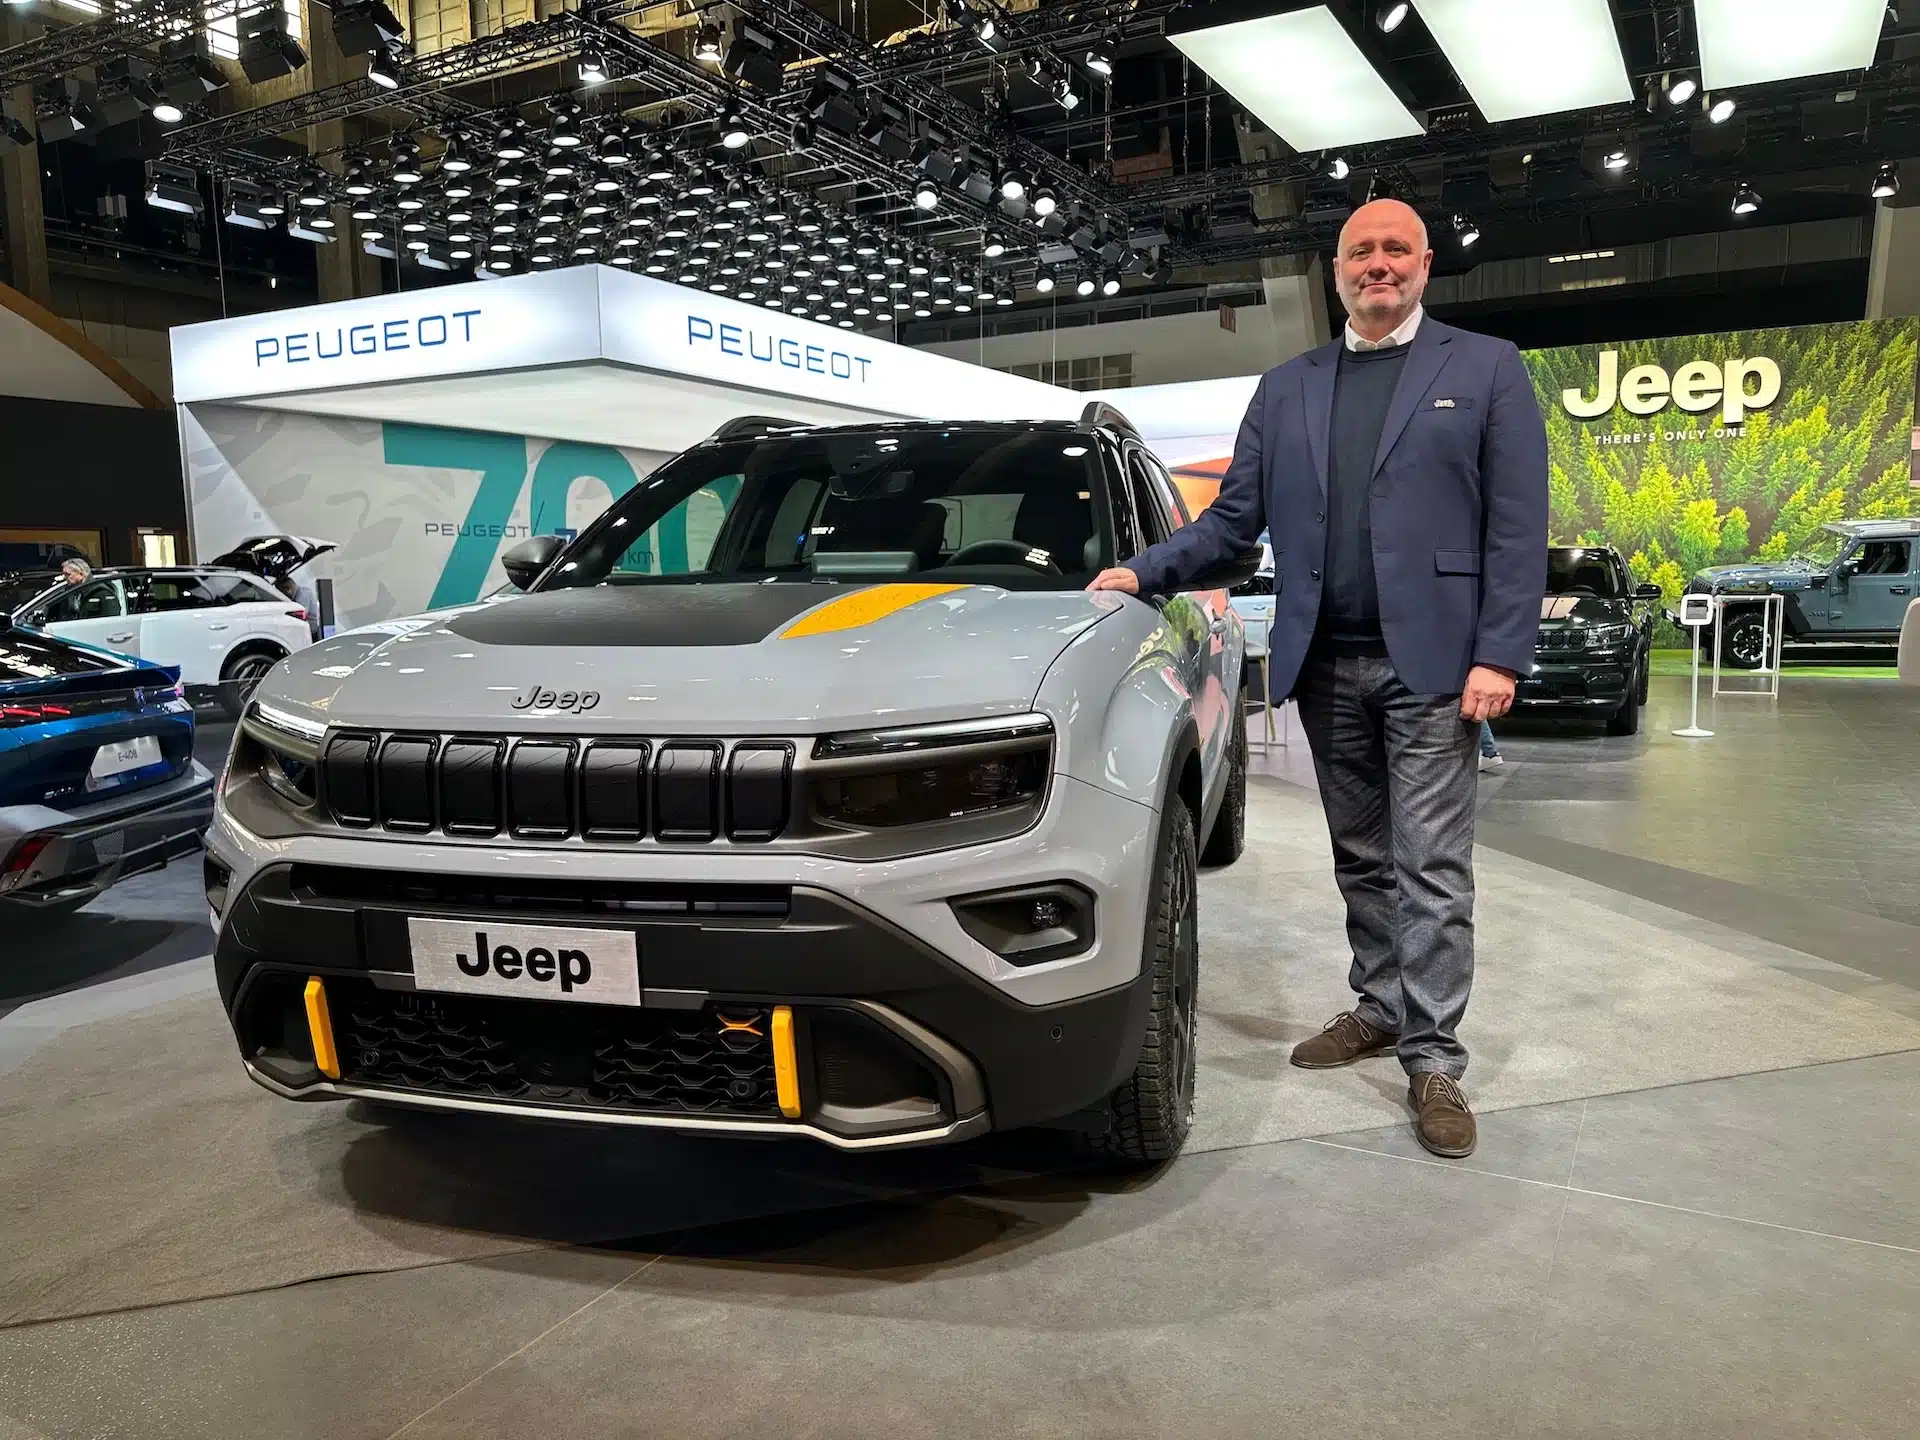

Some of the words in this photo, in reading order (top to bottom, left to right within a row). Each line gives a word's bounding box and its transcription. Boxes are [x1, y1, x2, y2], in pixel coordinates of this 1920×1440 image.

[256, 309, 481, 367] PEUGEOT
[687, 315, 872, 383] PEUGEOT
[1562, 350, 1782, 424] Jeep
[1594, 431, 1656, 446] THERE'S
[1664, 429, 1707, 442] ONLY
[1713, 427, 1748, 438] ONE
[425, 523, 529, 538] PEUGEOT
[627, 548, 655, 565] km
[510, 685, 600, 714] Jeep
[455, 931, 592, 993] Jeep
